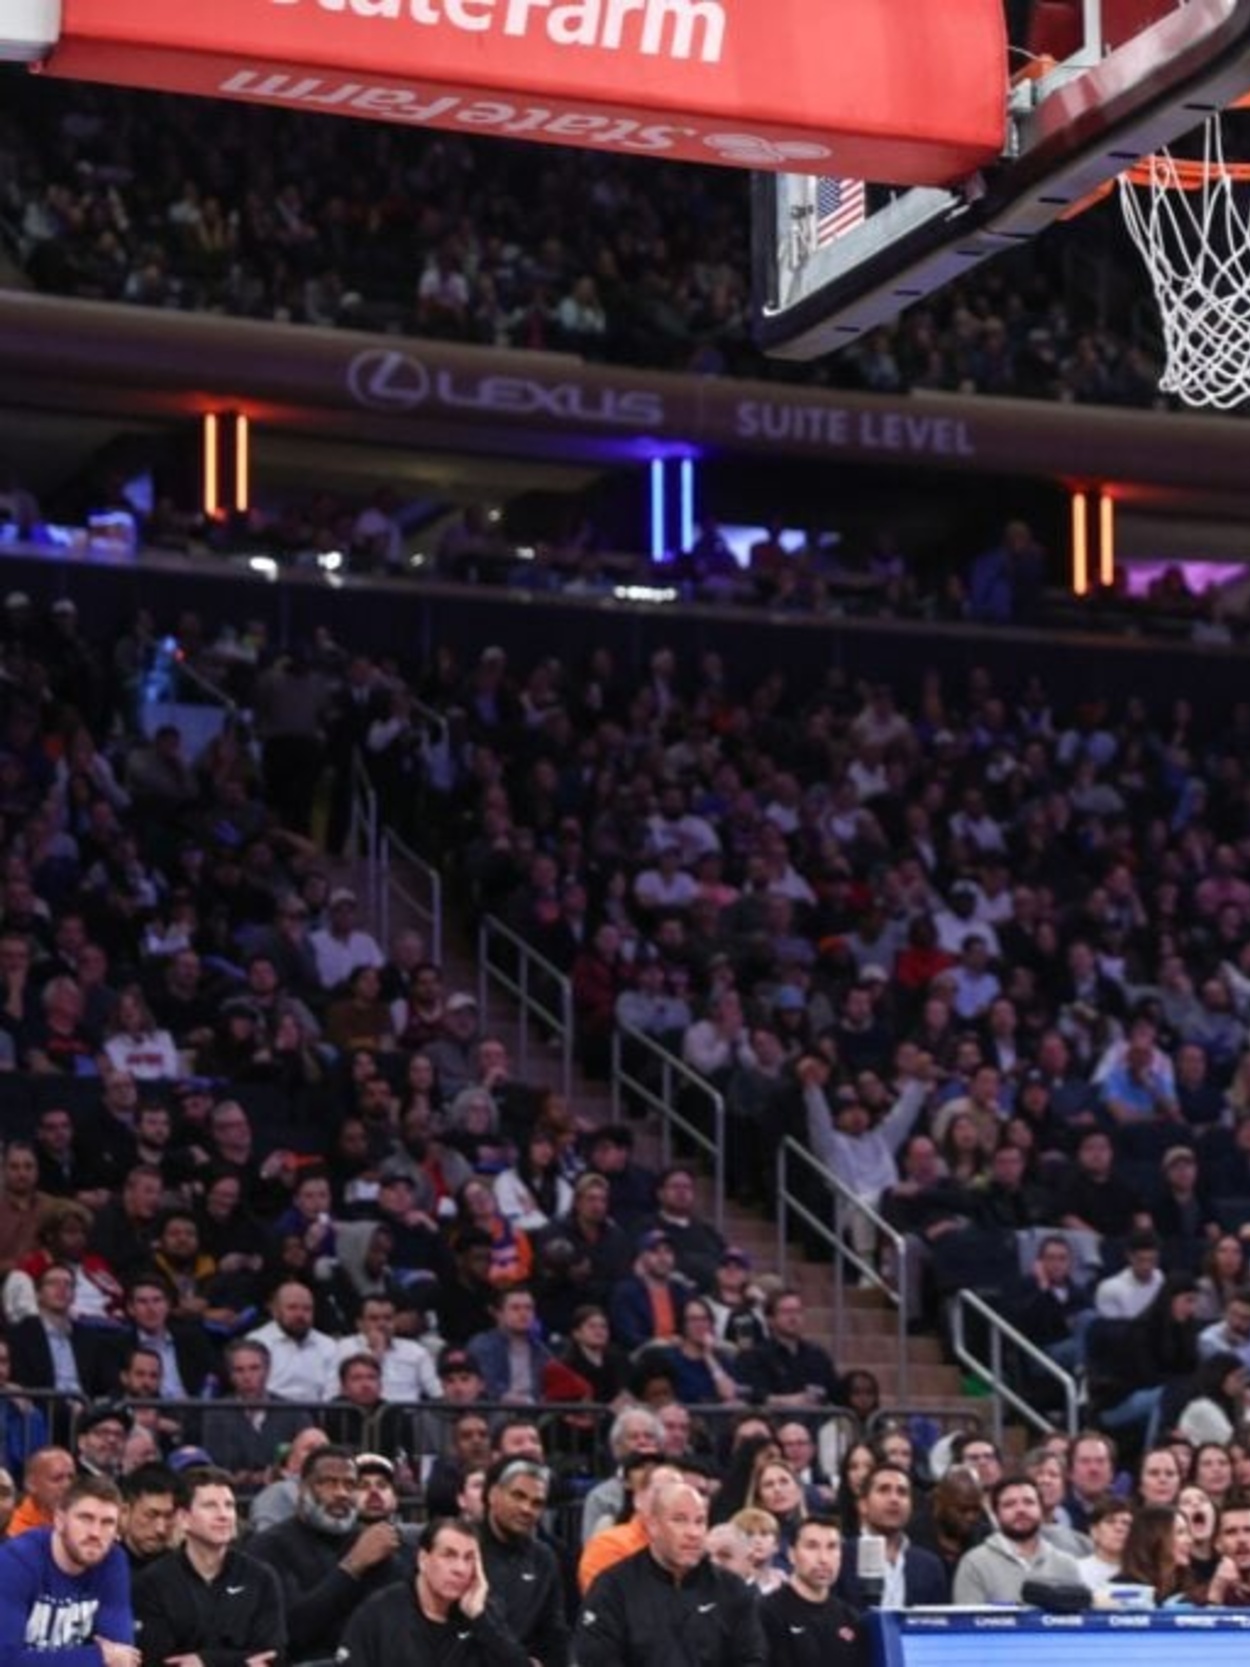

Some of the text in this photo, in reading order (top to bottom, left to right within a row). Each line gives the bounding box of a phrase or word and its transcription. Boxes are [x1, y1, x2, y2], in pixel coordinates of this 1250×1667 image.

[438, 369, 664, 425] LEXUS
[737, 400, 974, 456] SUITE LEVEL
